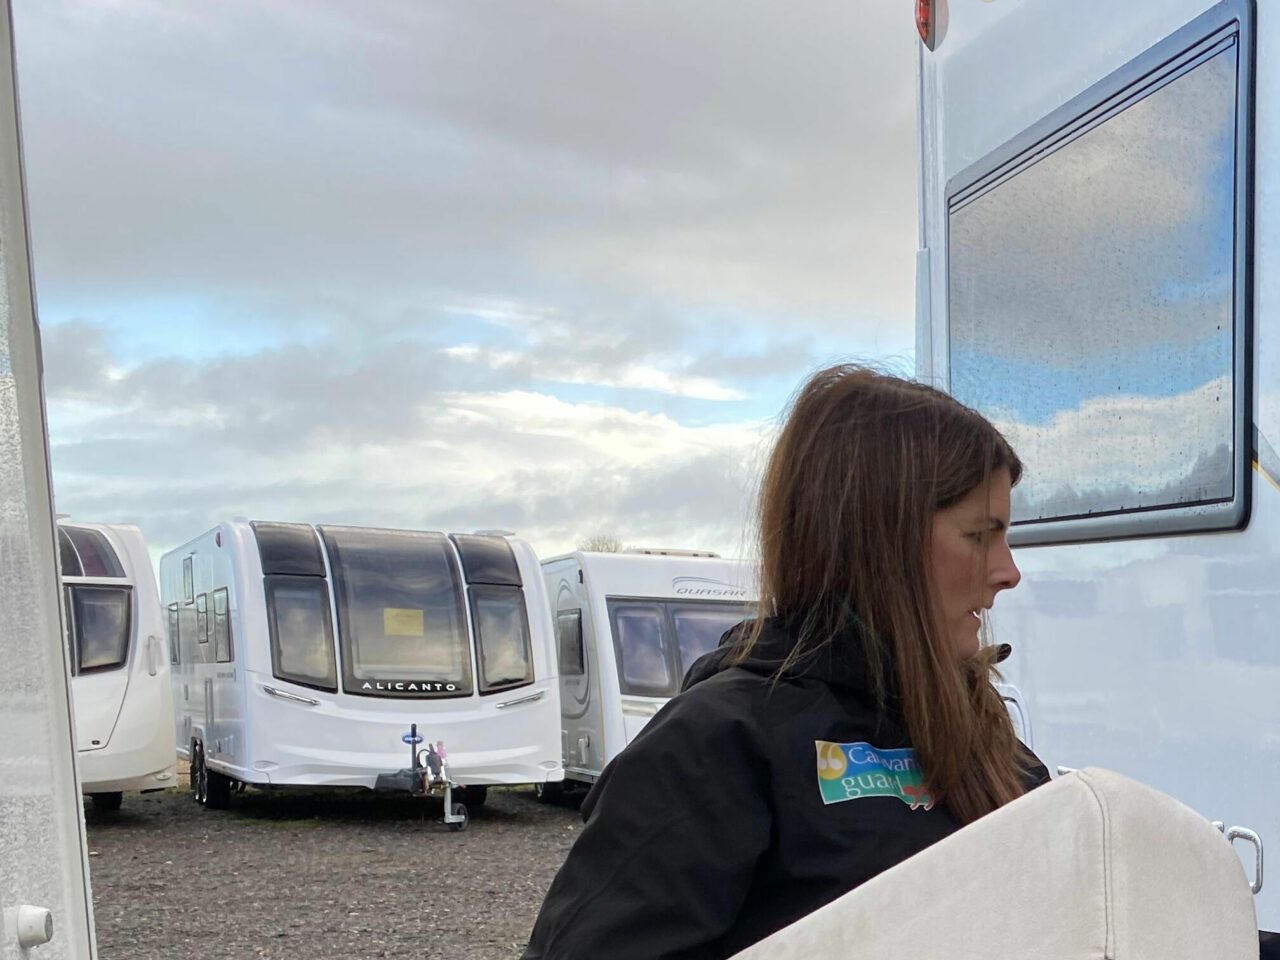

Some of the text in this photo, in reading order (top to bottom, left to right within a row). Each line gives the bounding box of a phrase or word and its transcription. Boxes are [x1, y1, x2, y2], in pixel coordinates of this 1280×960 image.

[676, 588, 747, 596] QUASAR
[362, 682, 456, 691] ALICANTO
[848, 746, 915, 771] Cavan
